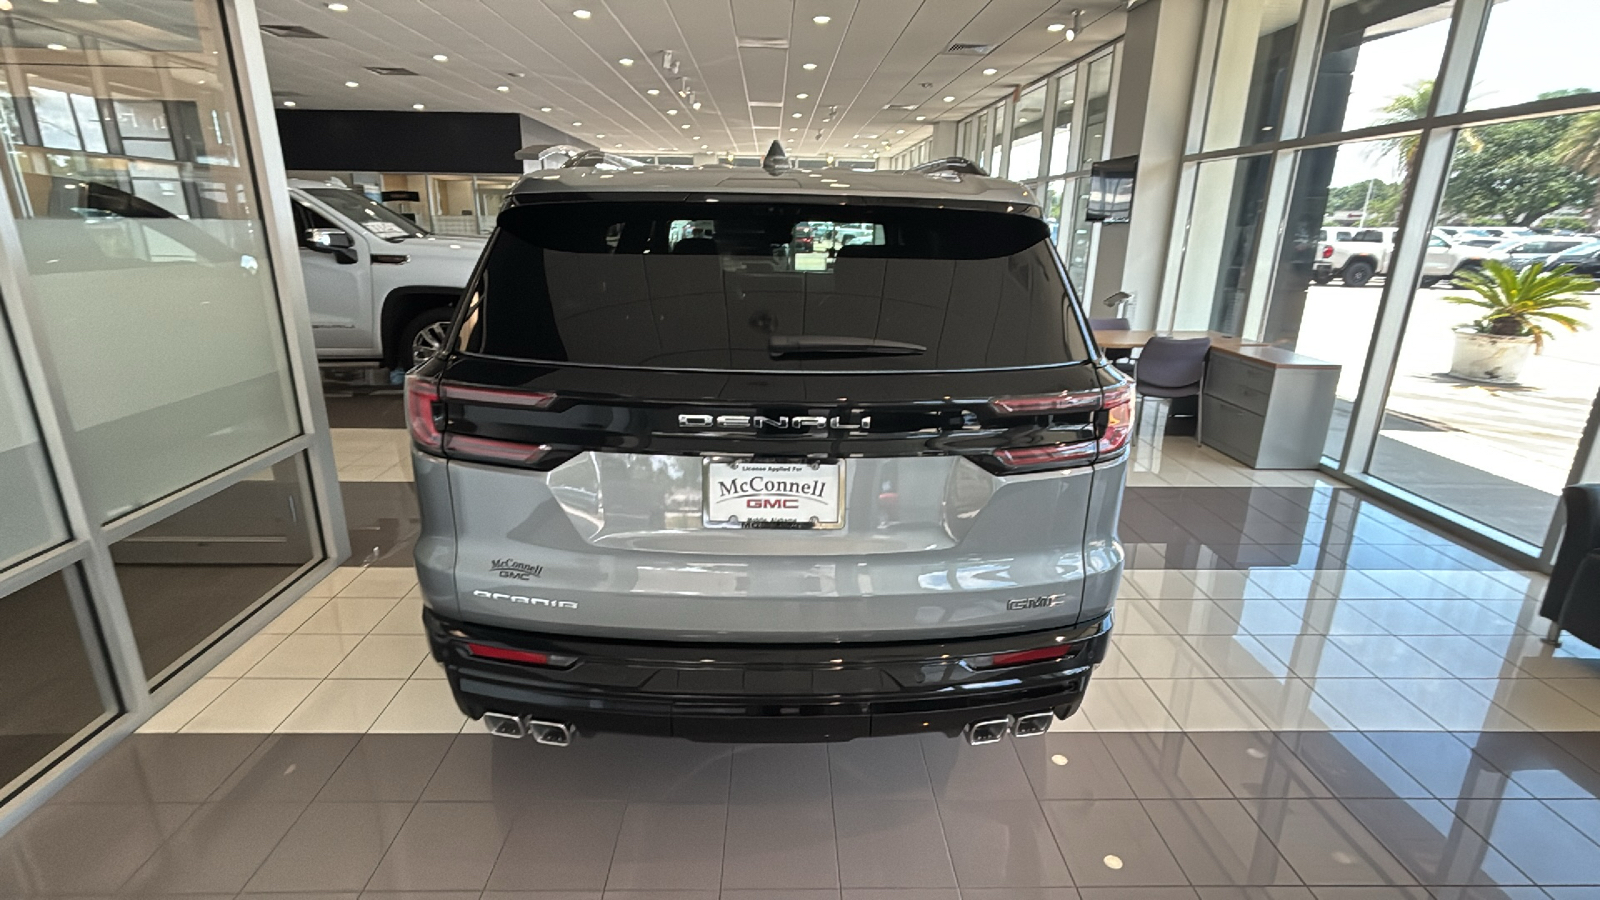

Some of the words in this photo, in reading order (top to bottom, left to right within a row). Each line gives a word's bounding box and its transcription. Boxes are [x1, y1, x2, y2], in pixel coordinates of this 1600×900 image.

[678, 414, 871, 429] DENALI
[718, 476, 826, 498] McConnell
[746, 499, 799, 509] GMC
[491, 558, 543, 575] McConnell
[499, 571, 530, 581] GMC
[473, 590, 578, 609] ACADIA
[1006, 593, 1066, 610] GMC
